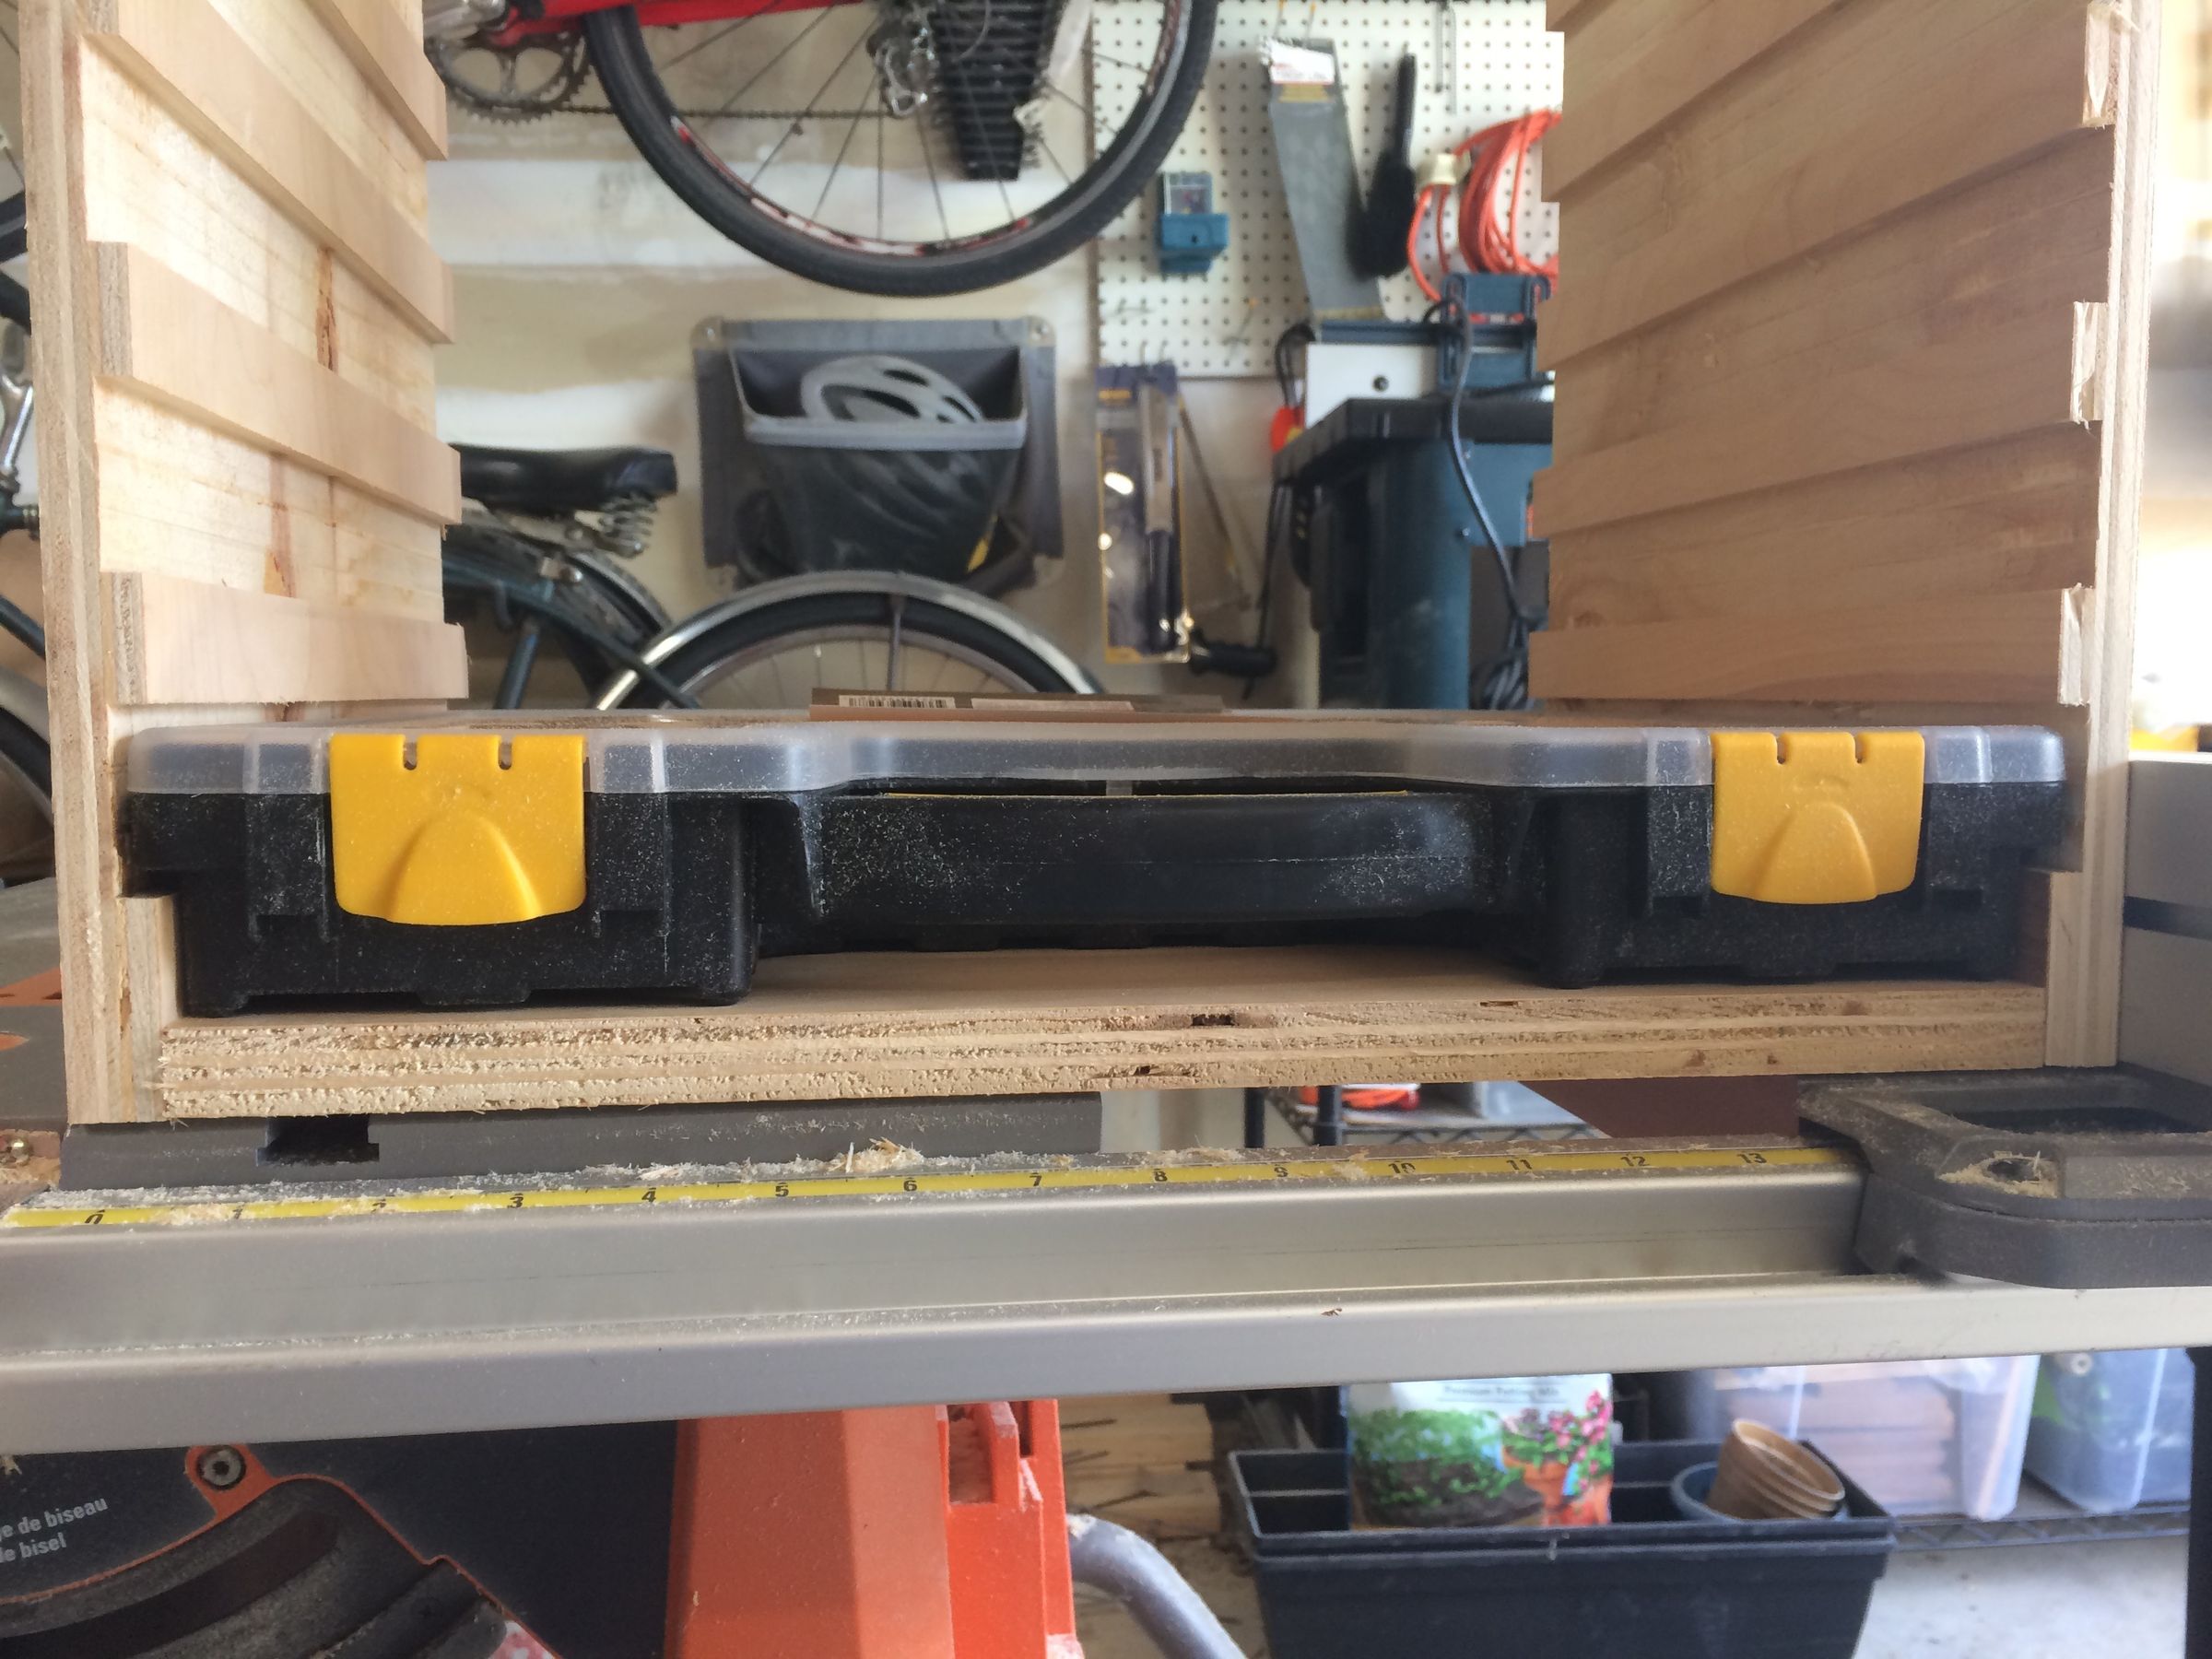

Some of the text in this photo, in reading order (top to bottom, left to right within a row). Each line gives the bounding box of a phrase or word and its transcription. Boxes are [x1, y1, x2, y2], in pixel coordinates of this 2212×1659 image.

[507, 1195, 524, 1208] 3
[641, 1189, 657, 1203] 4
[774, 1184, 790, 1197] 5
[902, 1179, 918, 1192] 6
[1029, 1174, 1042, 1187] 7
[1153, 1170, 1169, 1182] 8
[1387, 1161, 1417, 1174] 10
[1505, 1159, 1533, 1171] 11
[1620, 1155, 1651, 1167] 12
[1736, 1152, 1768, 1164] 13
[18, 1516, 41, 1535] de
[43, 1498, 109, 1528] biseau
[18, 1532, 67, 1559] bisel
